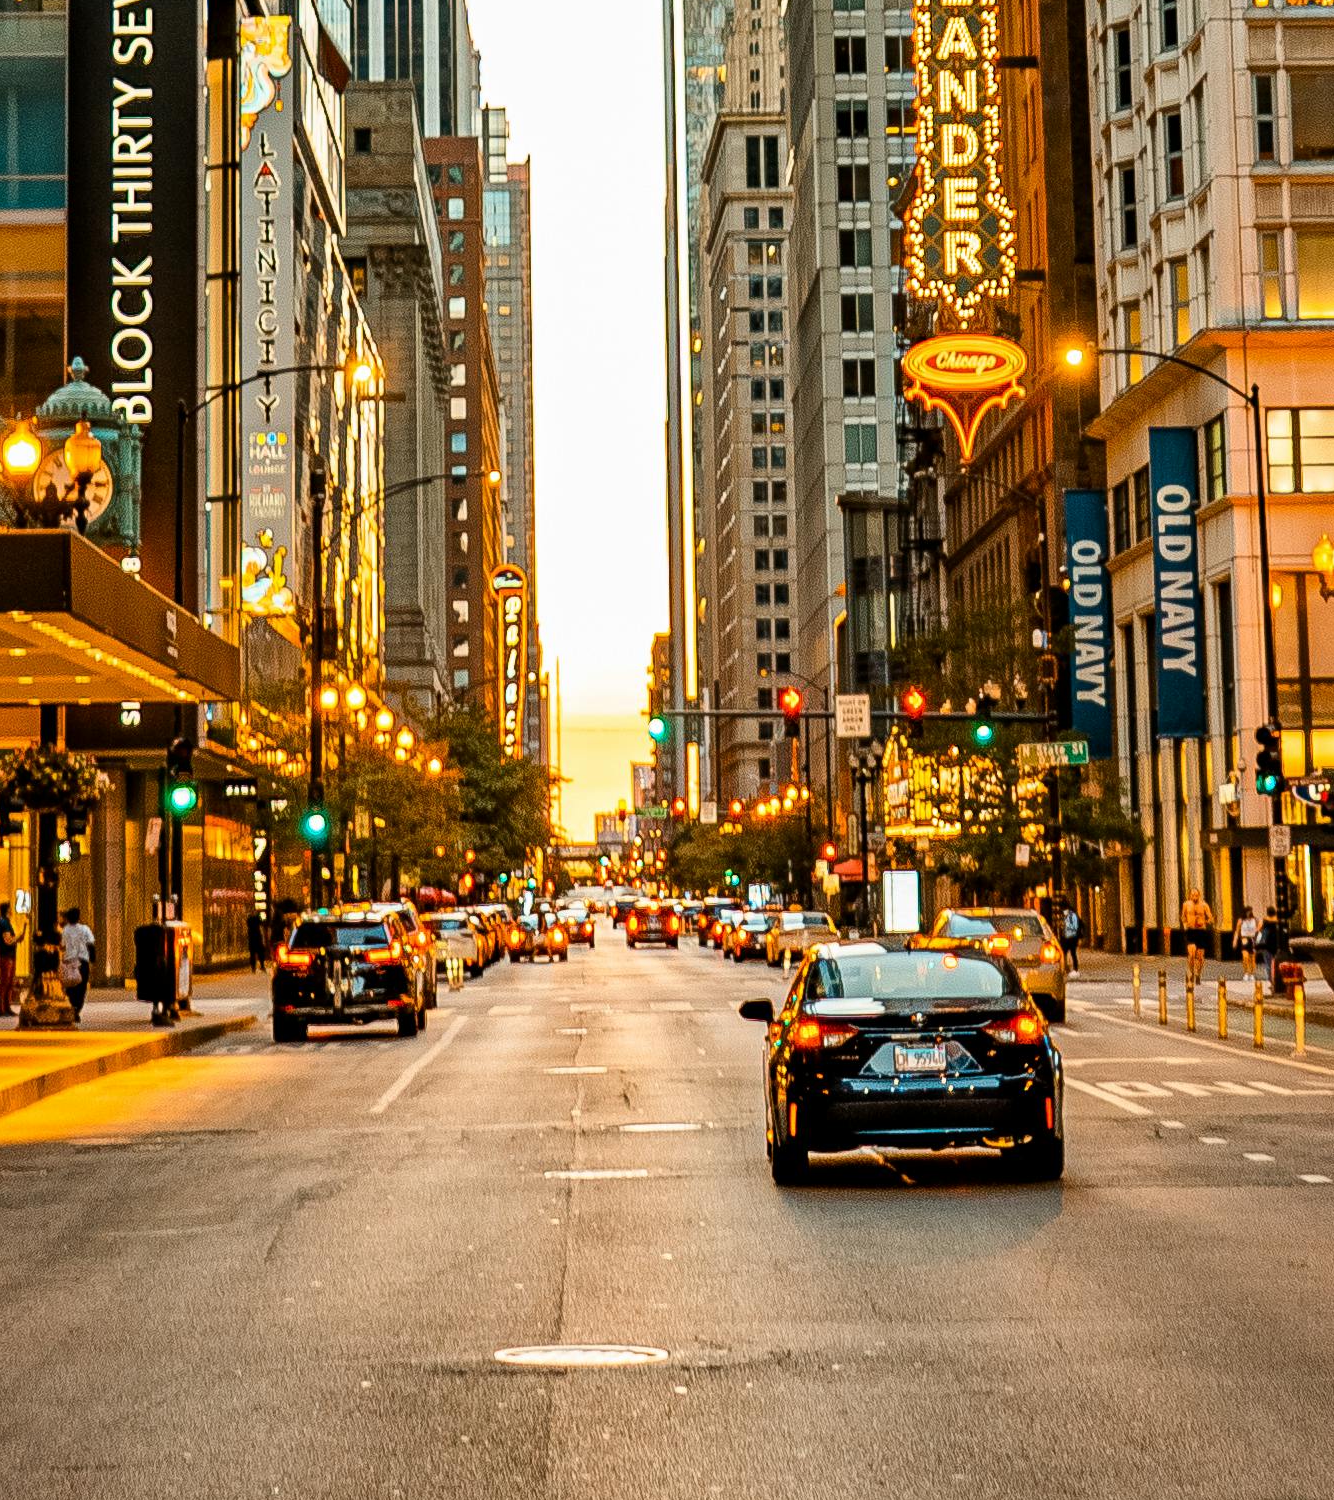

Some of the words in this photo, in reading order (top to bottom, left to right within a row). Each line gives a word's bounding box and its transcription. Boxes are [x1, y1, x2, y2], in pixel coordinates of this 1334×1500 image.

[112, 82, 153, 242] THIRTY
[253, 131, 280, 424] LATINICITY
[112, 258, 153, 424] BLOCK
[935, 350, 997, 374] Chicago
[1156, 485, 1191, 562] OLD
[1072, 540, 1100, 608] OLD
[1074, 616, 1106, 708] NAVY
[1158, 571, 1197, 678] NAVY
